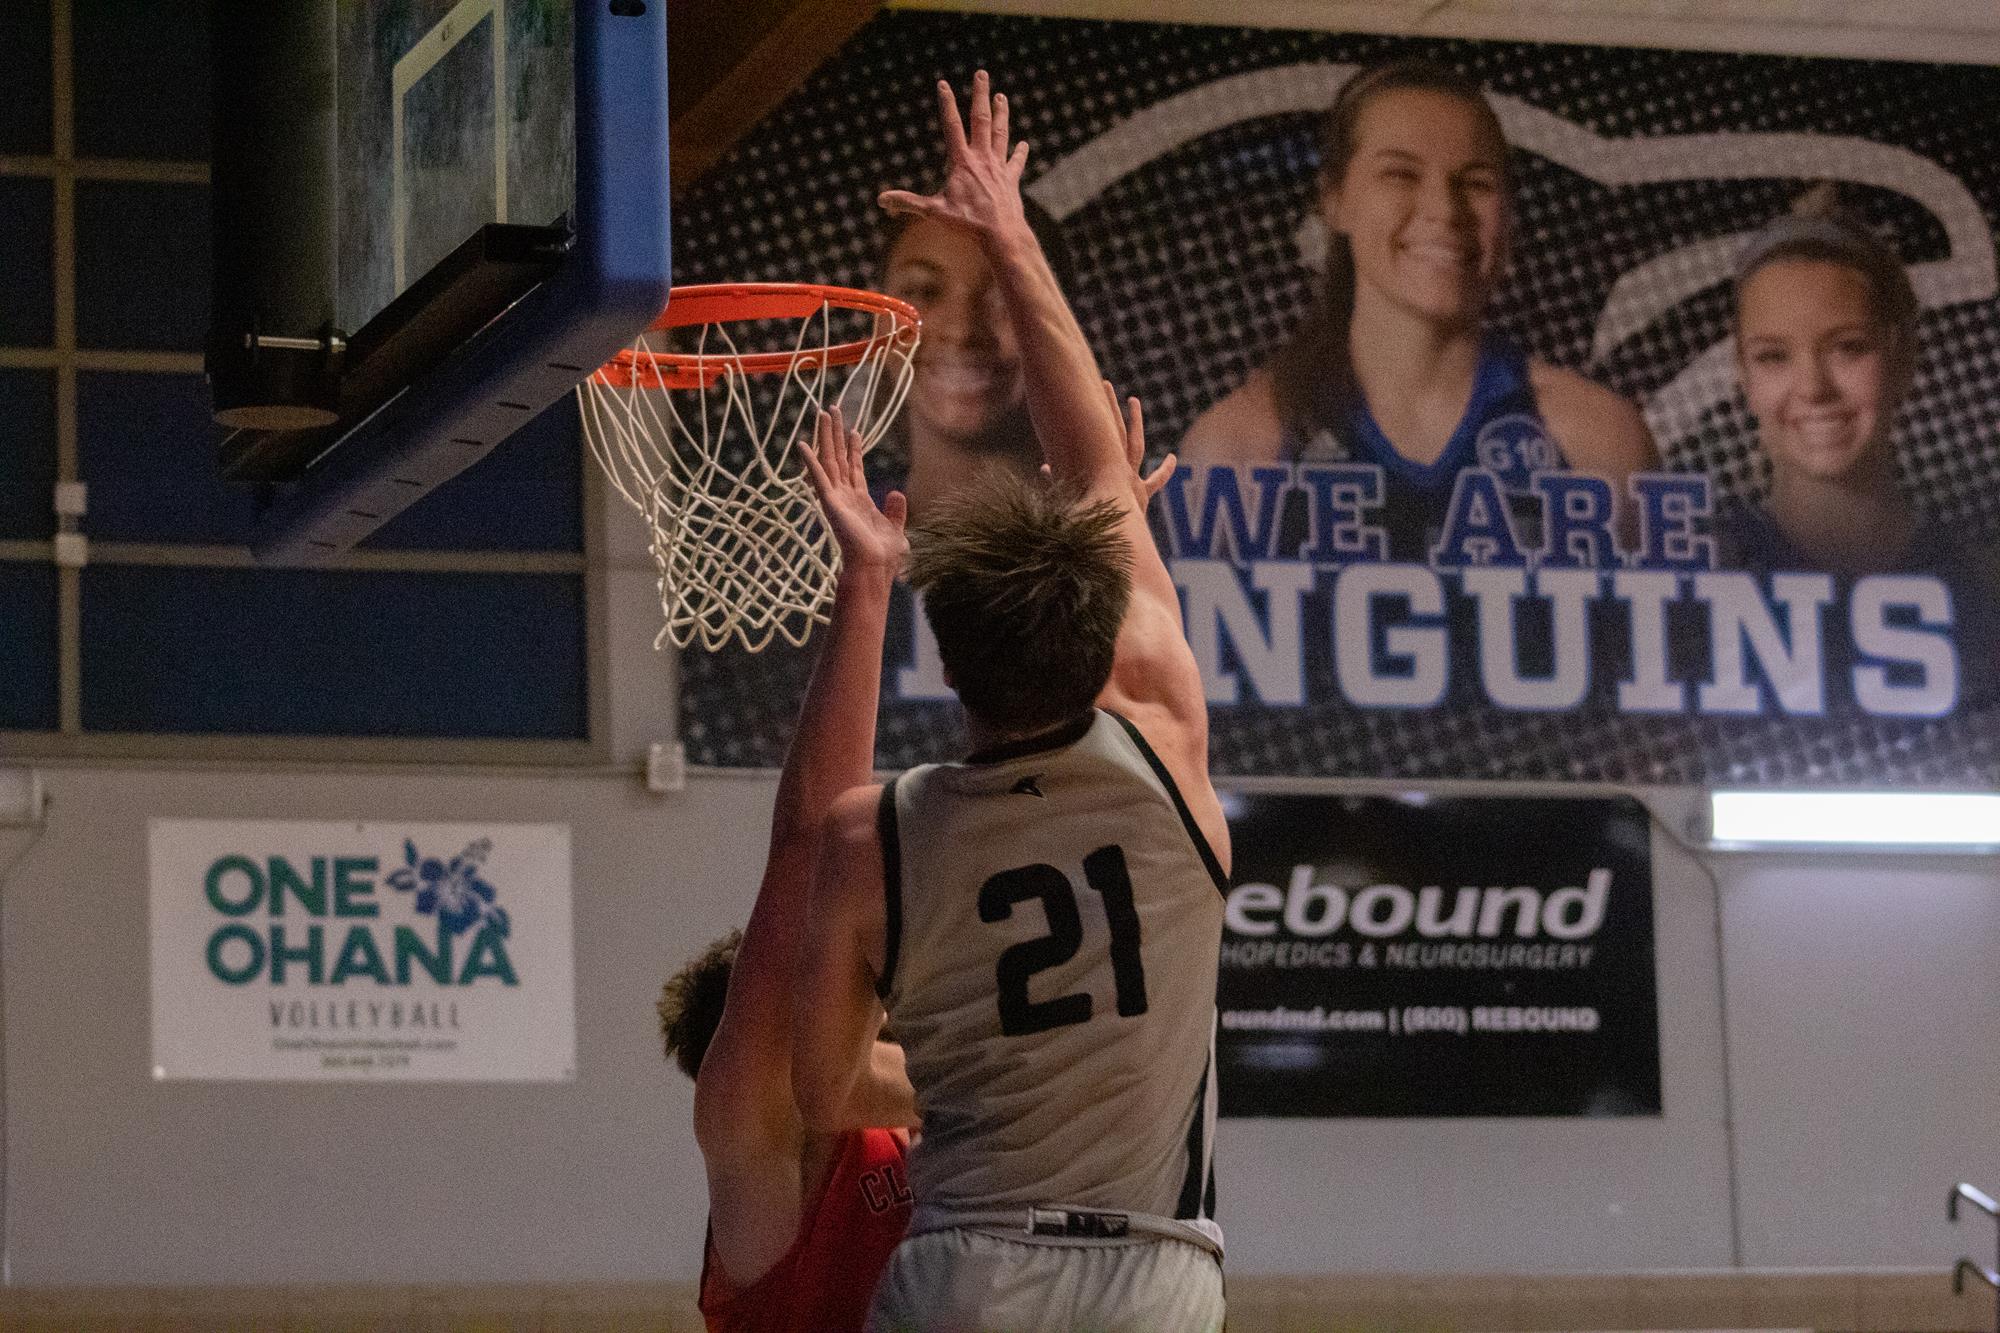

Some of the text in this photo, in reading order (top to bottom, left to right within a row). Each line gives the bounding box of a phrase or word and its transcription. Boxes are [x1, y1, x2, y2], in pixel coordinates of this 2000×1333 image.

[1162, 463, 1718, 575] WE ARE
[900, 560, 1959, 717] NGUINS
[205, 854, 380, 917] ONE
[1224, 865, 1613, 939] ebound
[205, 923, 519, 986] OHANA
[976, 844, 1148, 1037] 21
[1221, 942, 1592, 969] HOPEDICS & NEUROSURGERY
[1221, 1005, 1385, 1030] oundmd.com
[1471, 1007, 1600, 1031] REBOUND
[859, 1166, 914, 1215] CL
